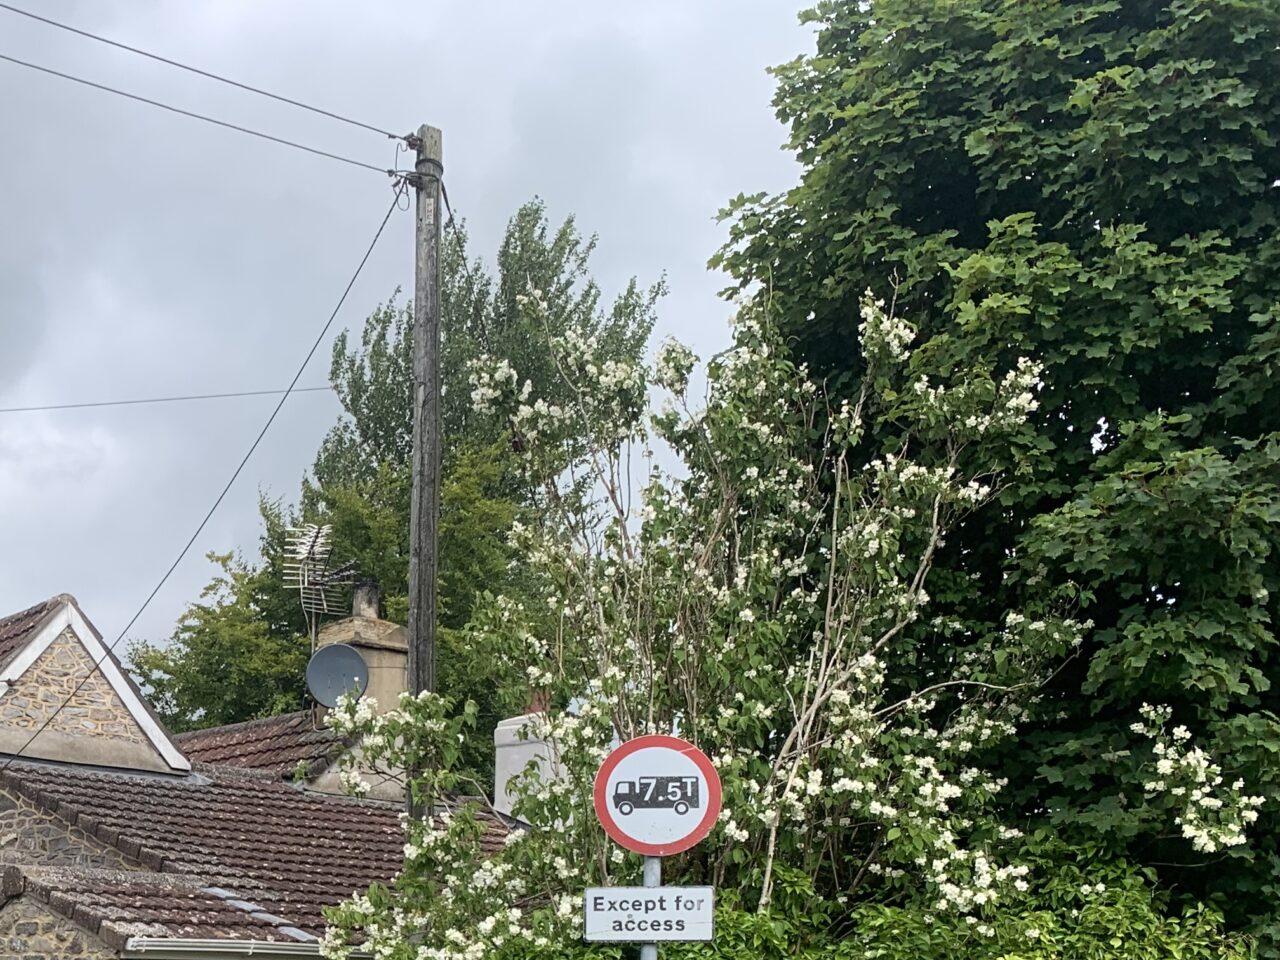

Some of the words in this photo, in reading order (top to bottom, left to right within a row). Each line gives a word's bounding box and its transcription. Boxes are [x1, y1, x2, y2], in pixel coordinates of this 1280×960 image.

[640, 777, 697, 802] 7.5T
[593, 895, 667, 914] Except
[674, 895, 705, 911] for
[612, 919, 686, 932] access
